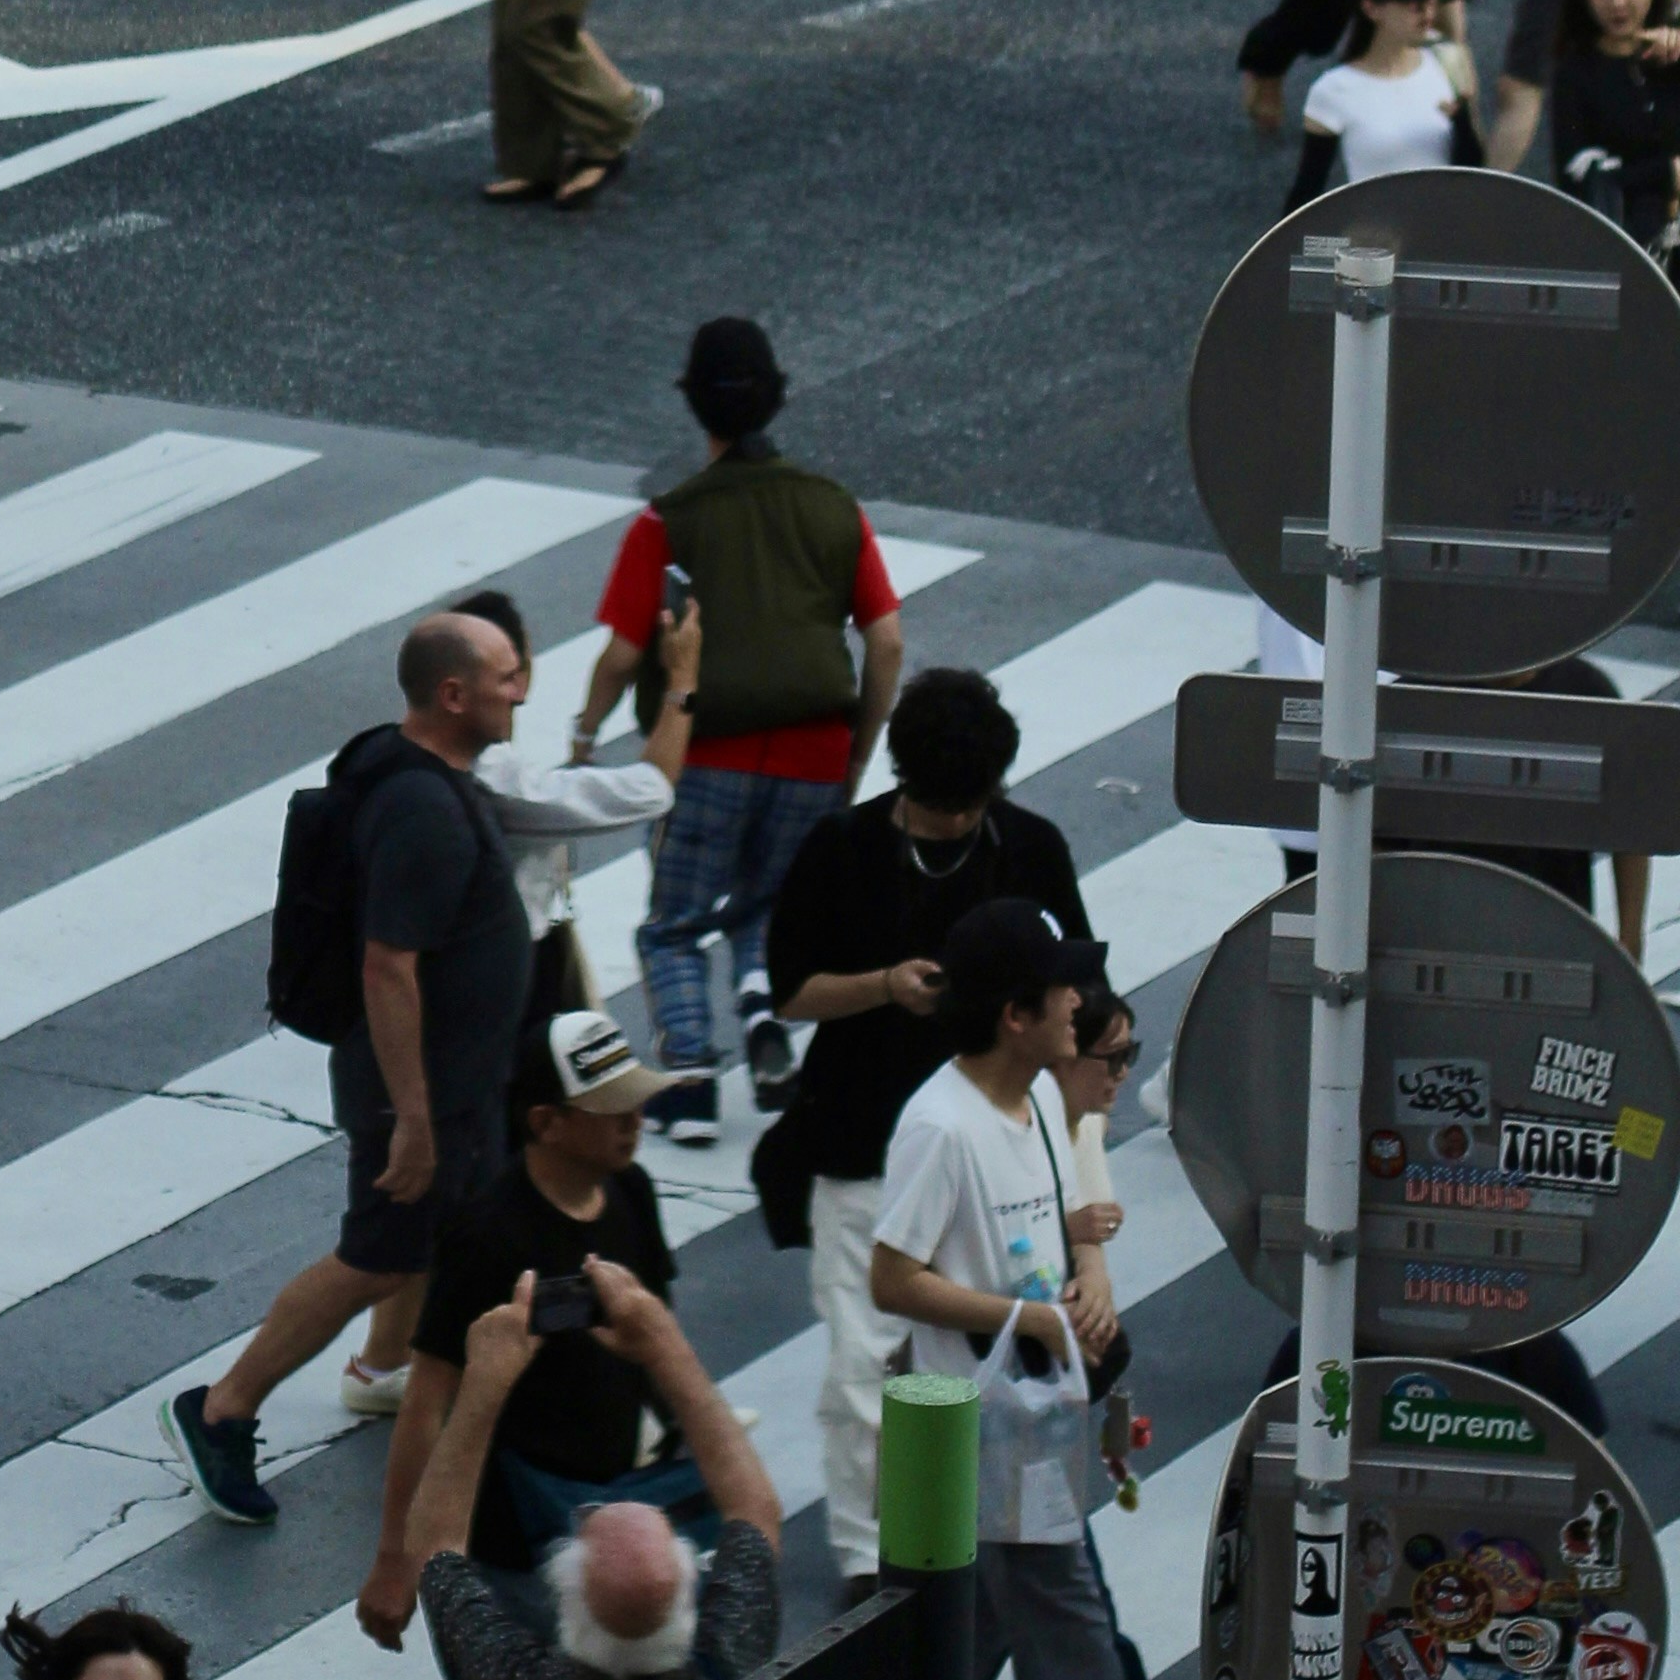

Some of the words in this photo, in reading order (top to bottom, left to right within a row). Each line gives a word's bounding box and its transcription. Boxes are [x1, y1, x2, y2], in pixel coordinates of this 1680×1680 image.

[1538, 1036, 1615, 1078] FINCH
[1530, 1065, 1611, 1108] BRIMZ
[1389, 1400, 1535, 1442] Supreme
